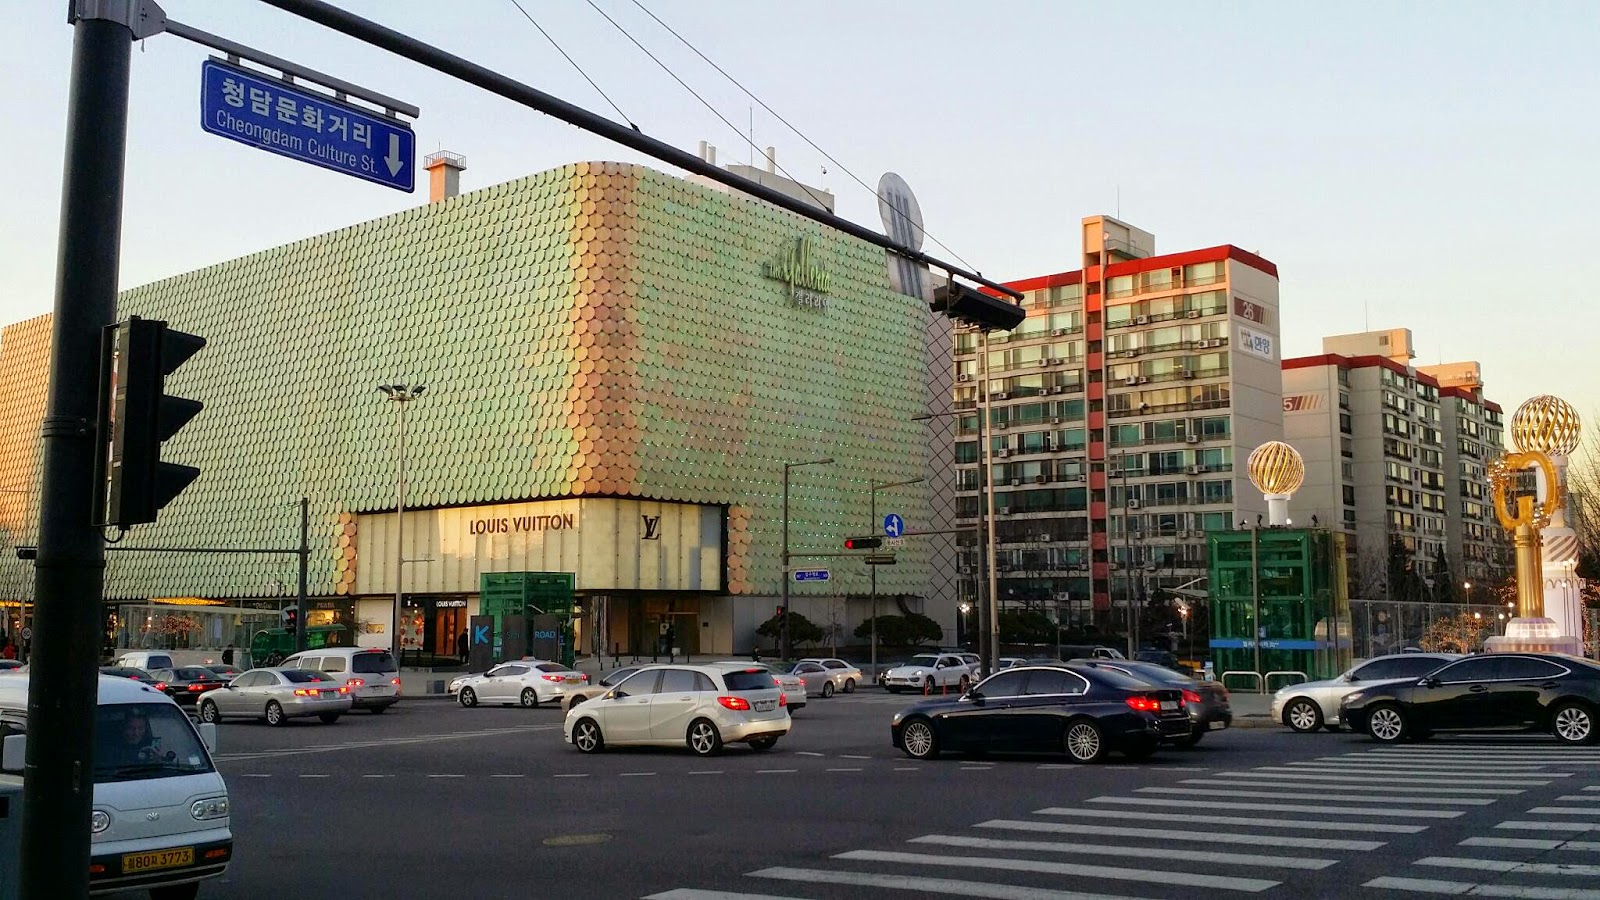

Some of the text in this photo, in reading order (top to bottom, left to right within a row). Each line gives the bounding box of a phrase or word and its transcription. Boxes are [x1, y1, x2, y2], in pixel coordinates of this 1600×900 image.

[222, 77, 372, 150] 청담문화거리
[216, 109, 379, 175] Cheongdam Culture St.
[1243, 301, 1254, 320] 26
[469, 513, 574, 535] LOUIS VUITTON
[641, 515, 661, 540] LV
[435, 600, 467, 608] LOUIS VUITTON
[474, 624, 490, 645] K
[534, 630, 556, 640] ROAD
[160, 851, 189, 865] 3773
